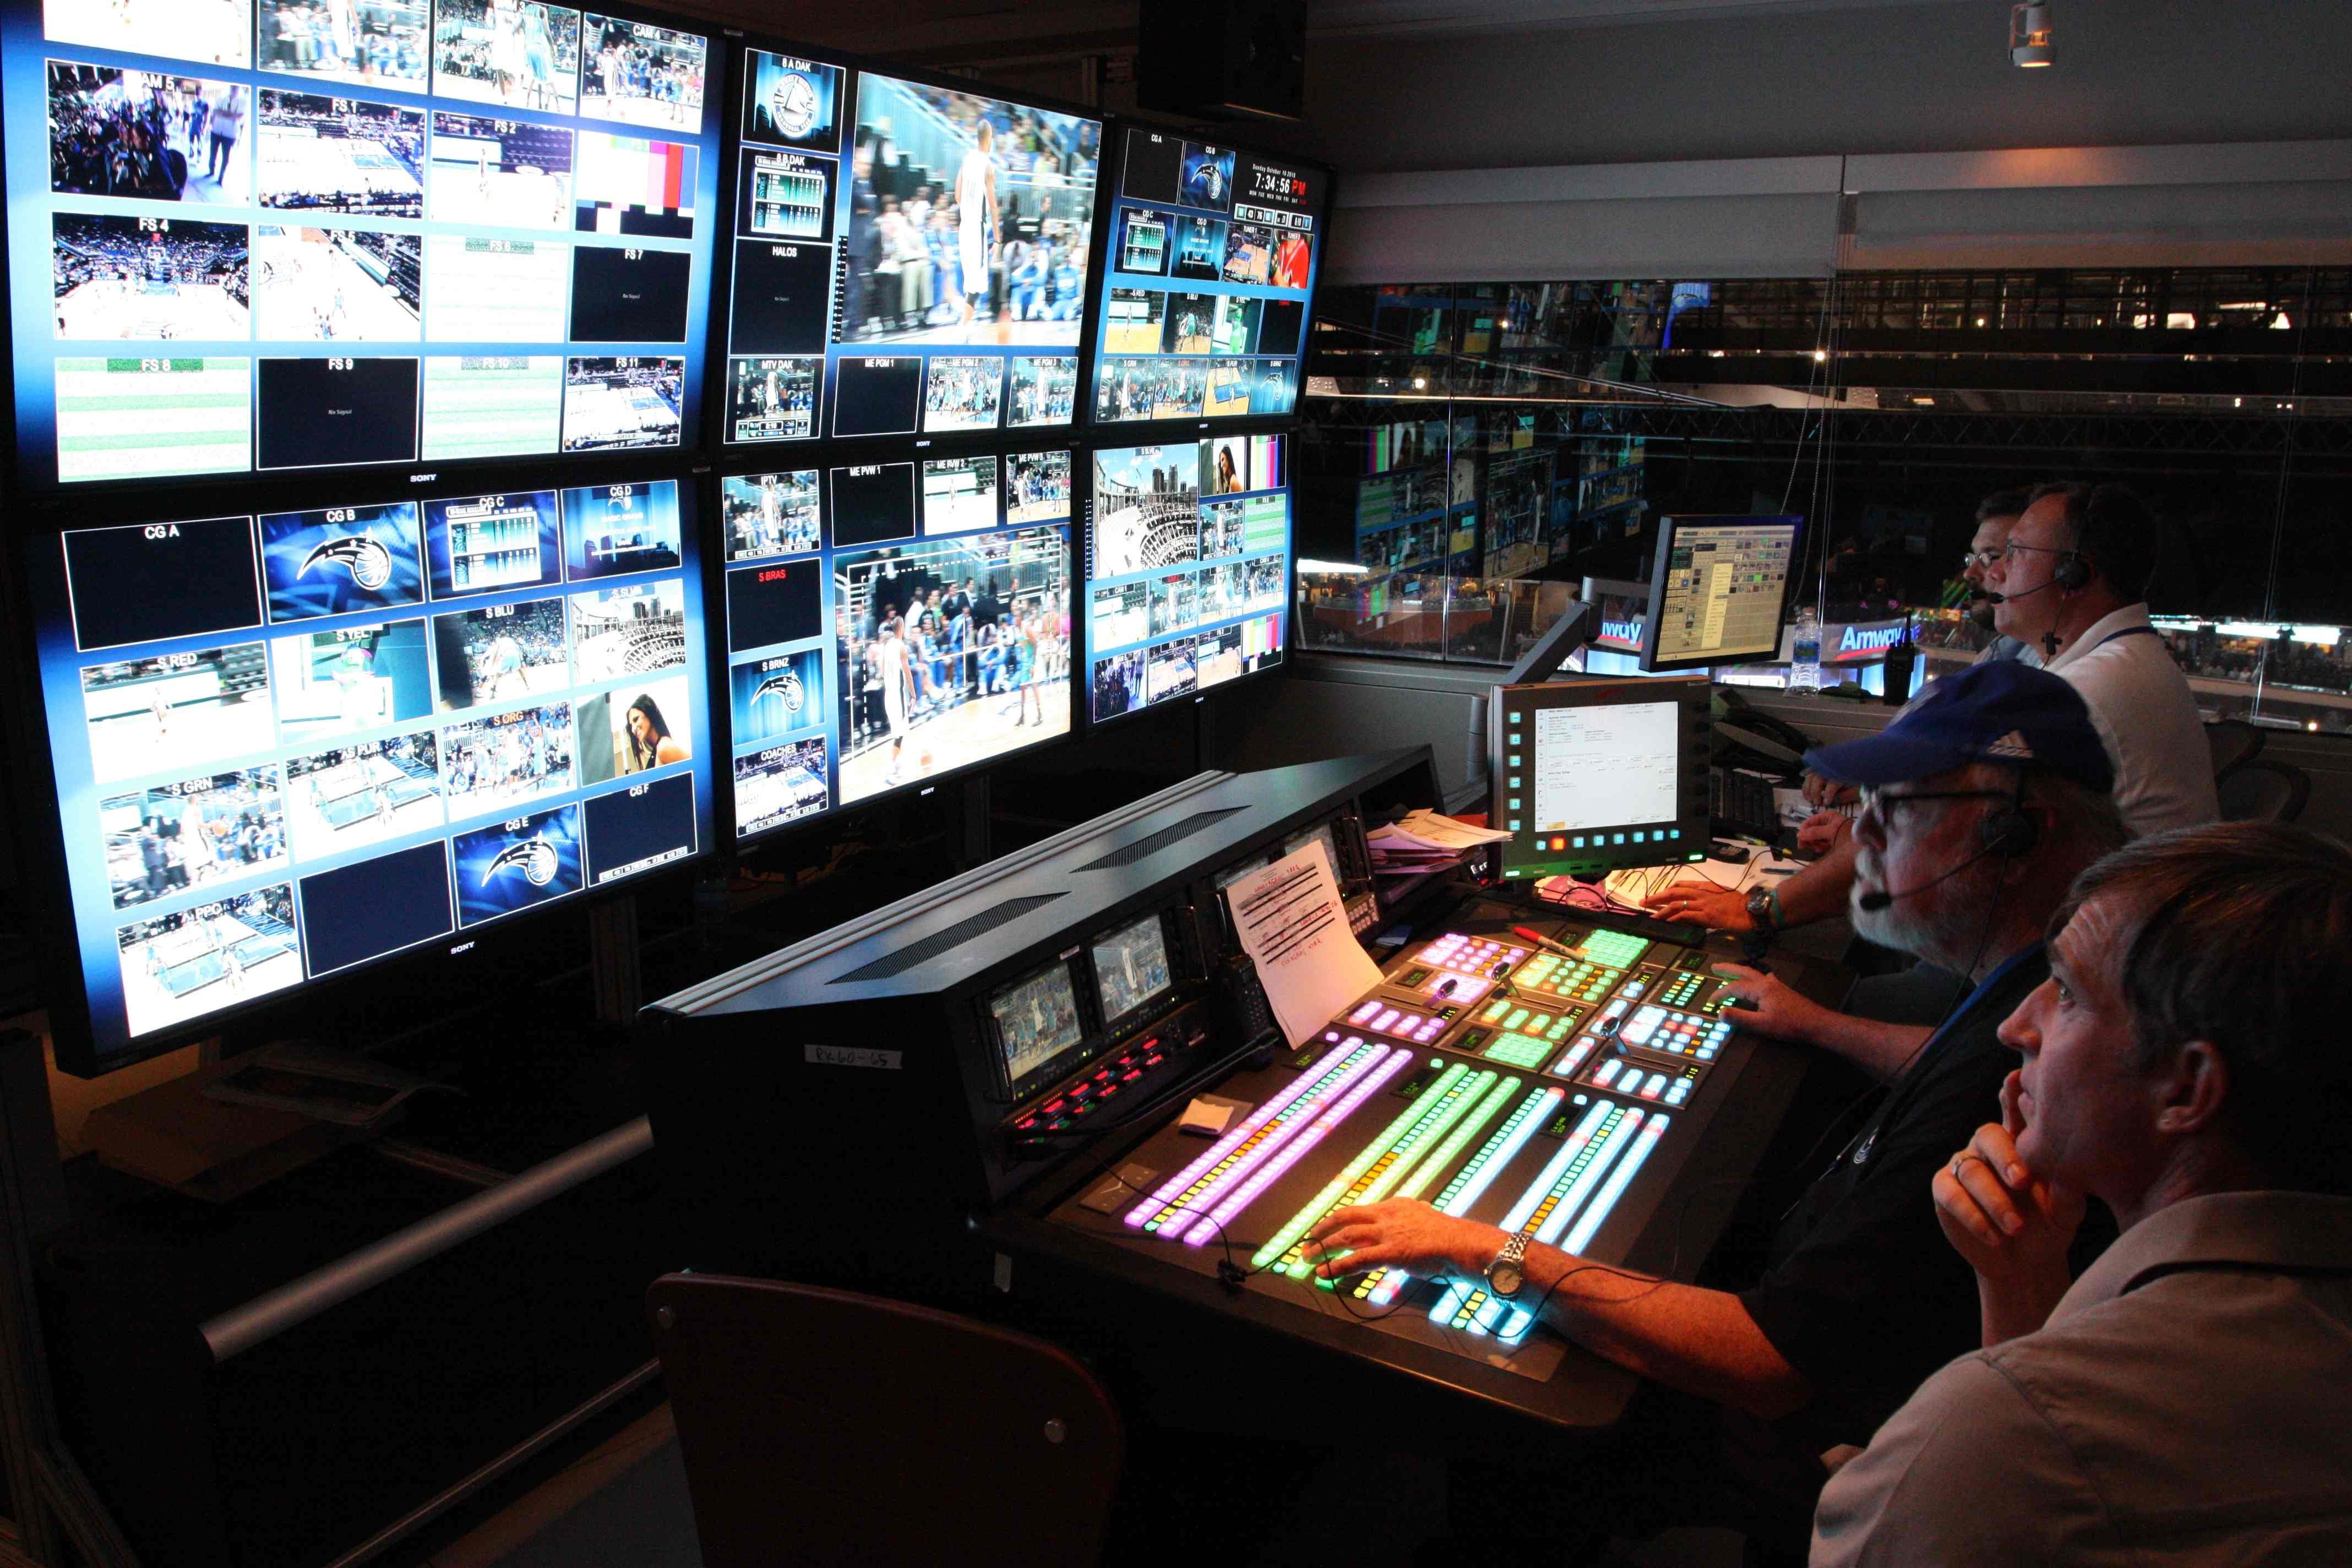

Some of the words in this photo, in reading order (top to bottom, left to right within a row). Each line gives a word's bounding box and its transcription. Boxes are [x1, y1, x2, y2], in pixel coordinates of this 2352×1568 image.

[633, 25, 653, 38] CAM
[654, 29, 660, 40] 4
[788, 59, 794, 68] A
[795, 61, 810, 72] DAK
[137, 73, 163, 89] AM
[166, 77, 175, 90] 5
[331, 98, 349, 111] FS
[351, 101, 357, 113] 1
[494, 120, 508, 132] FS
[509, 123, 516, 134] 2
[1151, 134, 1158, 142] CG
[782, 154, 788, 164] B
[790, 156, 805, 166] DAK
[1253, 164, 1266, 172] Sunday
[1267, 167, 1281, 175] October
[1256, 173, 1290, 194] 7:34:56
[1292, 179, 1306, 196] PM
[139, 217, 157, 231] FS
[160, 220, 169, 232] 4
[331, 230, 346, 242] FS
[348, 231, 356, 241] 5
[490, 239, 504, 251] FS
[772, 246, 797, 257] HALOS
[625, 249, 636, 259] FS
[637, 250, 643, 259] 7
[141, 359, 159, 372] FS
[162, 359, 171, 372] 8
[329, 358, 343, 369] FS
[346, 358, 353, 369] 9
[483, 358, 496, 368] FS
[498, 358, 509, 368] 10
[616, 358, 628, 367] FS
[629, 358, 639, 367] 11
[761, 361, 777, 369] MTV
[778, 360, 793, 369] DAK
[865, 359, 874, 368] ME
[876, 359, 890, 368] PGM
[952, 358, 960, 367] ME
[961, 358, 974, 367] PGM
[974, 358, 978, 367] 2
[938, 460, 946, 469] ME
[947, 460, 960, 469] PVW
[961, 459, 965, 467] 2
[1019, 455, 1027, 464] ME
[1028, 454, 1039, 462] PVW
[411, 474, 436, 482] SONY
[850, 468, 859, 477] ME
[861, 466, 876, 476] PVW
[878, 466, 881, 474] 1
[761, 475, 777, 486] IPTV
[610, 486, 623, 496] CG
[625, 486, 632, 495] D
[480, 497, 494, 508] CG
[497, 496, 504, 507] C
[326, 510, 344, 522] CG
[347, 509, 355, 520] B
[145, 526, 166, 539] CG
[169, 524, 179, 537] A
[759, 573, 764, 581] S
[765, 570, 786, 581] BRAS
[612, 589, 619, 599] S
[486, 608, 493, 619] S
[495, 605, 514, 617] BLU
[337, 631, 345, 642] S
[347, 628, 369, 640] YEL
[1602, 622, 1641, 645] way
[1840, 626, 1902, 647] Amway
[157, 657, 166, 668] S
[169, 653, 197, 667] RED
[762, 662, 767, 671] S
[769, 657, 789, 670] BRNZ
[493, 715, 500, 725] S
[502, 711, 523, 724] ORG
[357, 742, 380, 756] PUR
[761, 744, 796, 760] COACHES
[172, 783, 181, 796] S
[184, 777, 213, 793] GRN
[630, 787, 643, 797] CG
[644, 784, 650, 793] F
[505, 821, 520, 832] CG
[522, 818, 529, 827] E
[451, 941, 475, 955] SONY
